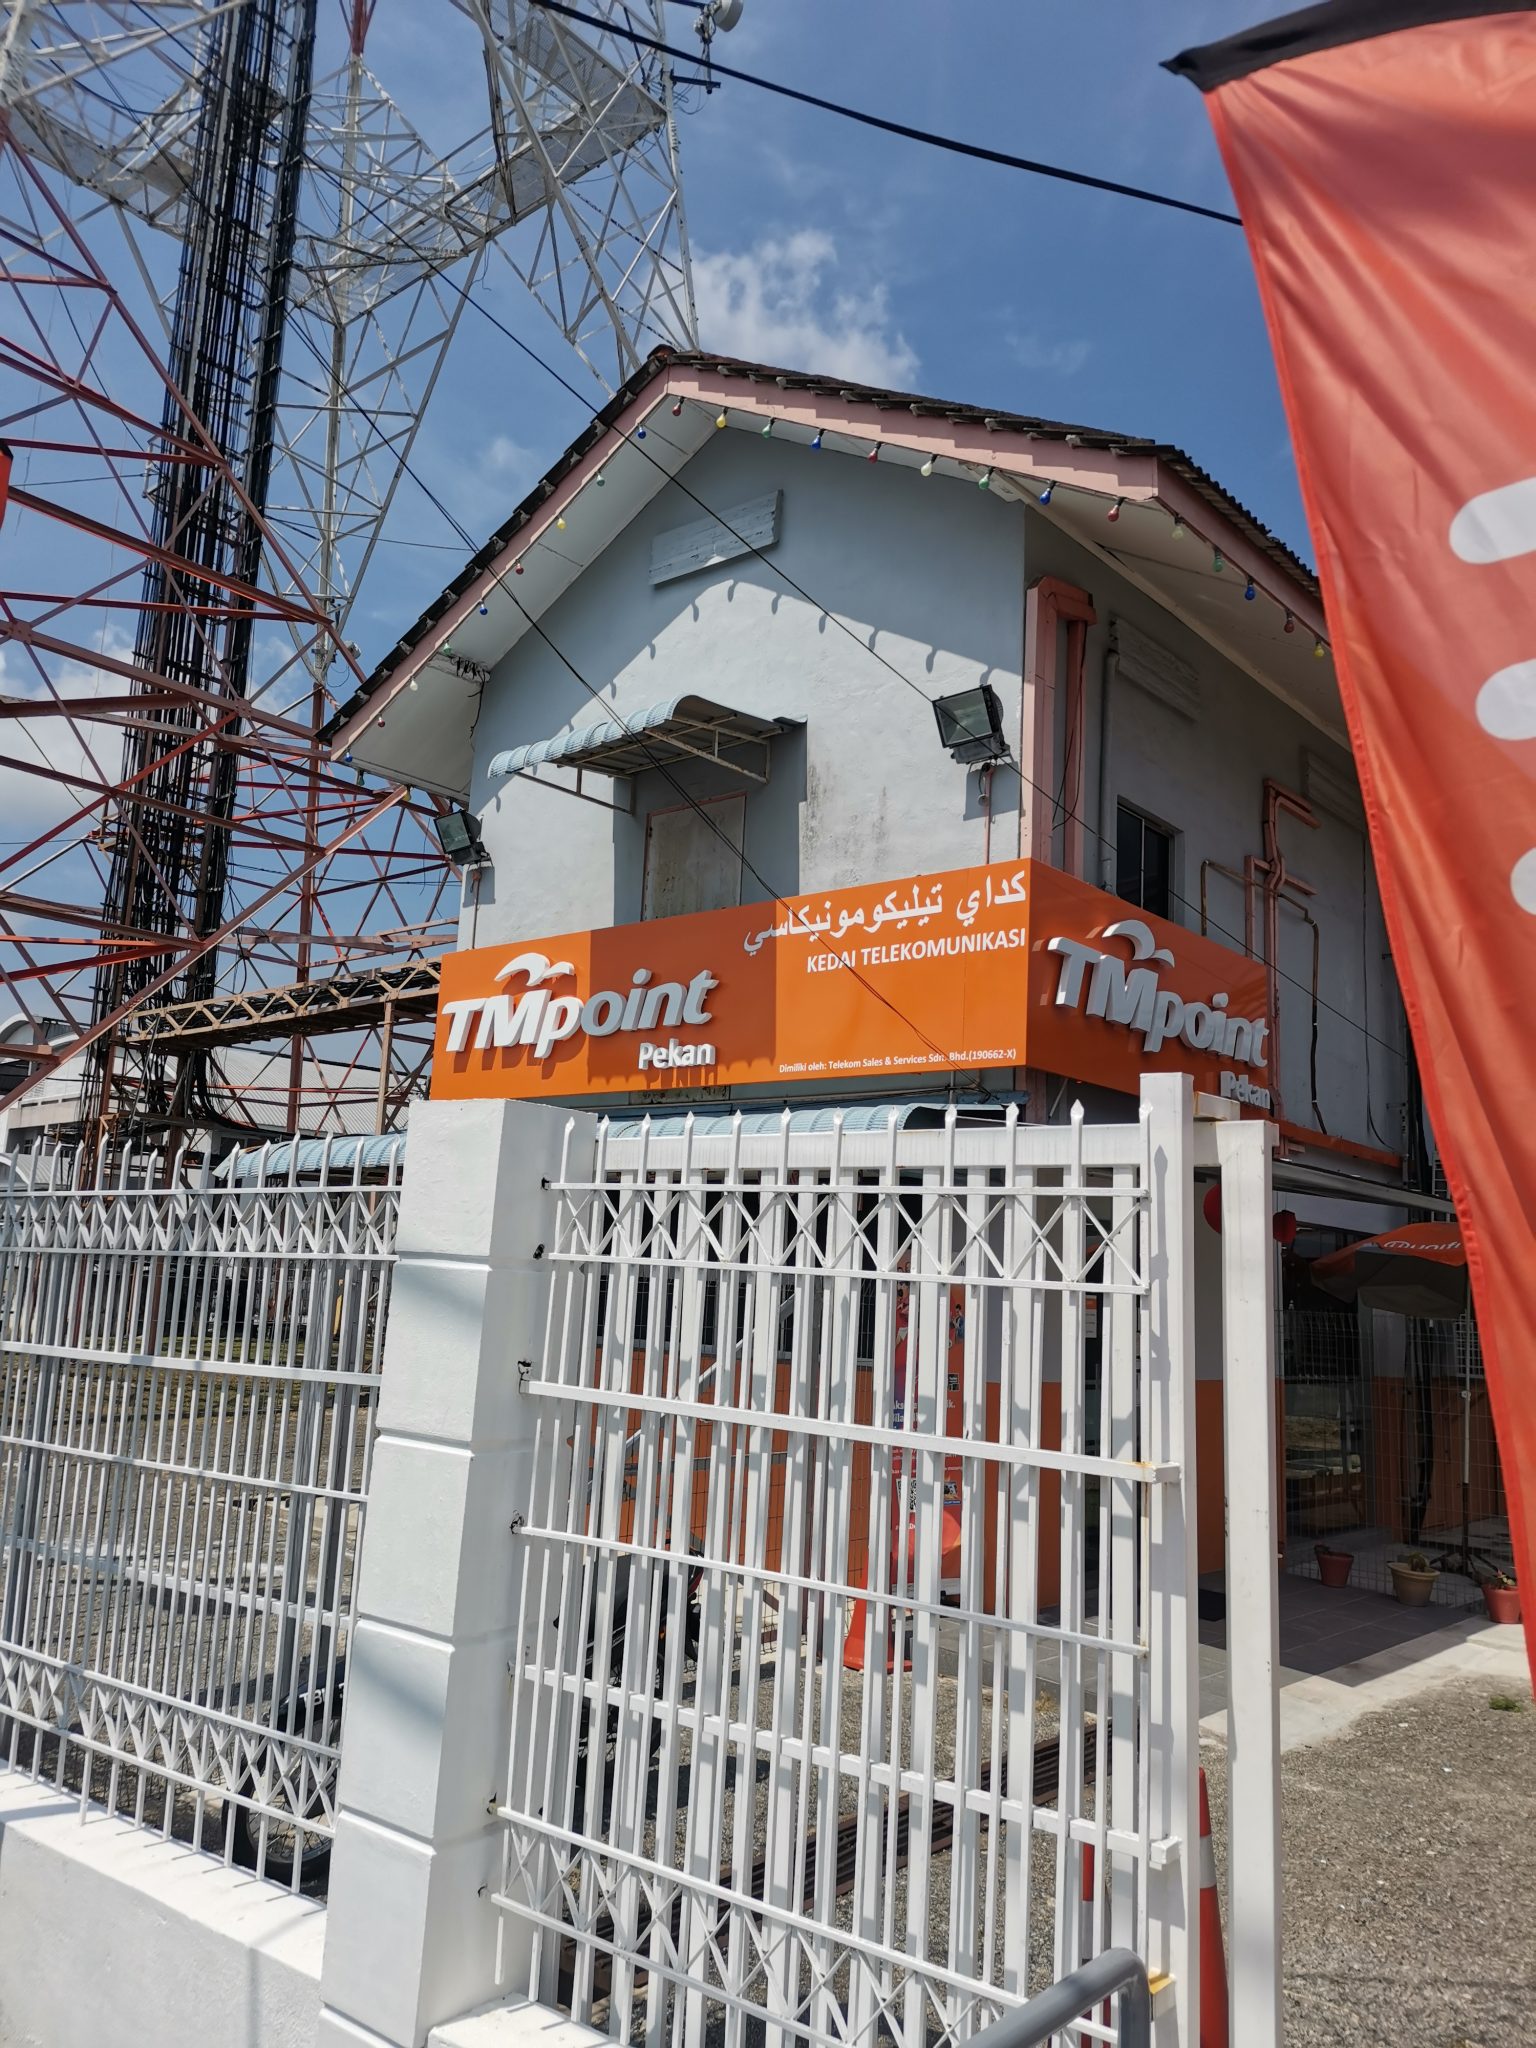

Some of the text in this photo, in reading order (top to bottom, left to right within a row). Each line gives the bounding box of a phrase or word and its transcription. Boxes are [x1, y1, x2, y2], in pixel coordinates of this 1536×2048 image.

[956, 870, 1026, 927] كداي
[807, 928, 1026, 973] KEDAI TELEKOMUNIKASI
[442, 968, 719, 1059] TMpoint
[1047, 935, 1269, 1068] TMpoint
[638, 1038, 716, 1070] Pekan
[779, 1062, 807, 1073] Dimiliki
[808, 1062, 827, 1071] oleh:
[829, 1060, 861, 1069] Telekom
[863, 1058, 883, 1067] Sales
[885, 1056, 892, 1065] &
[893, 1055, 927, 1065] Services
[1221, 1070, 1271, 1110] Pekan
